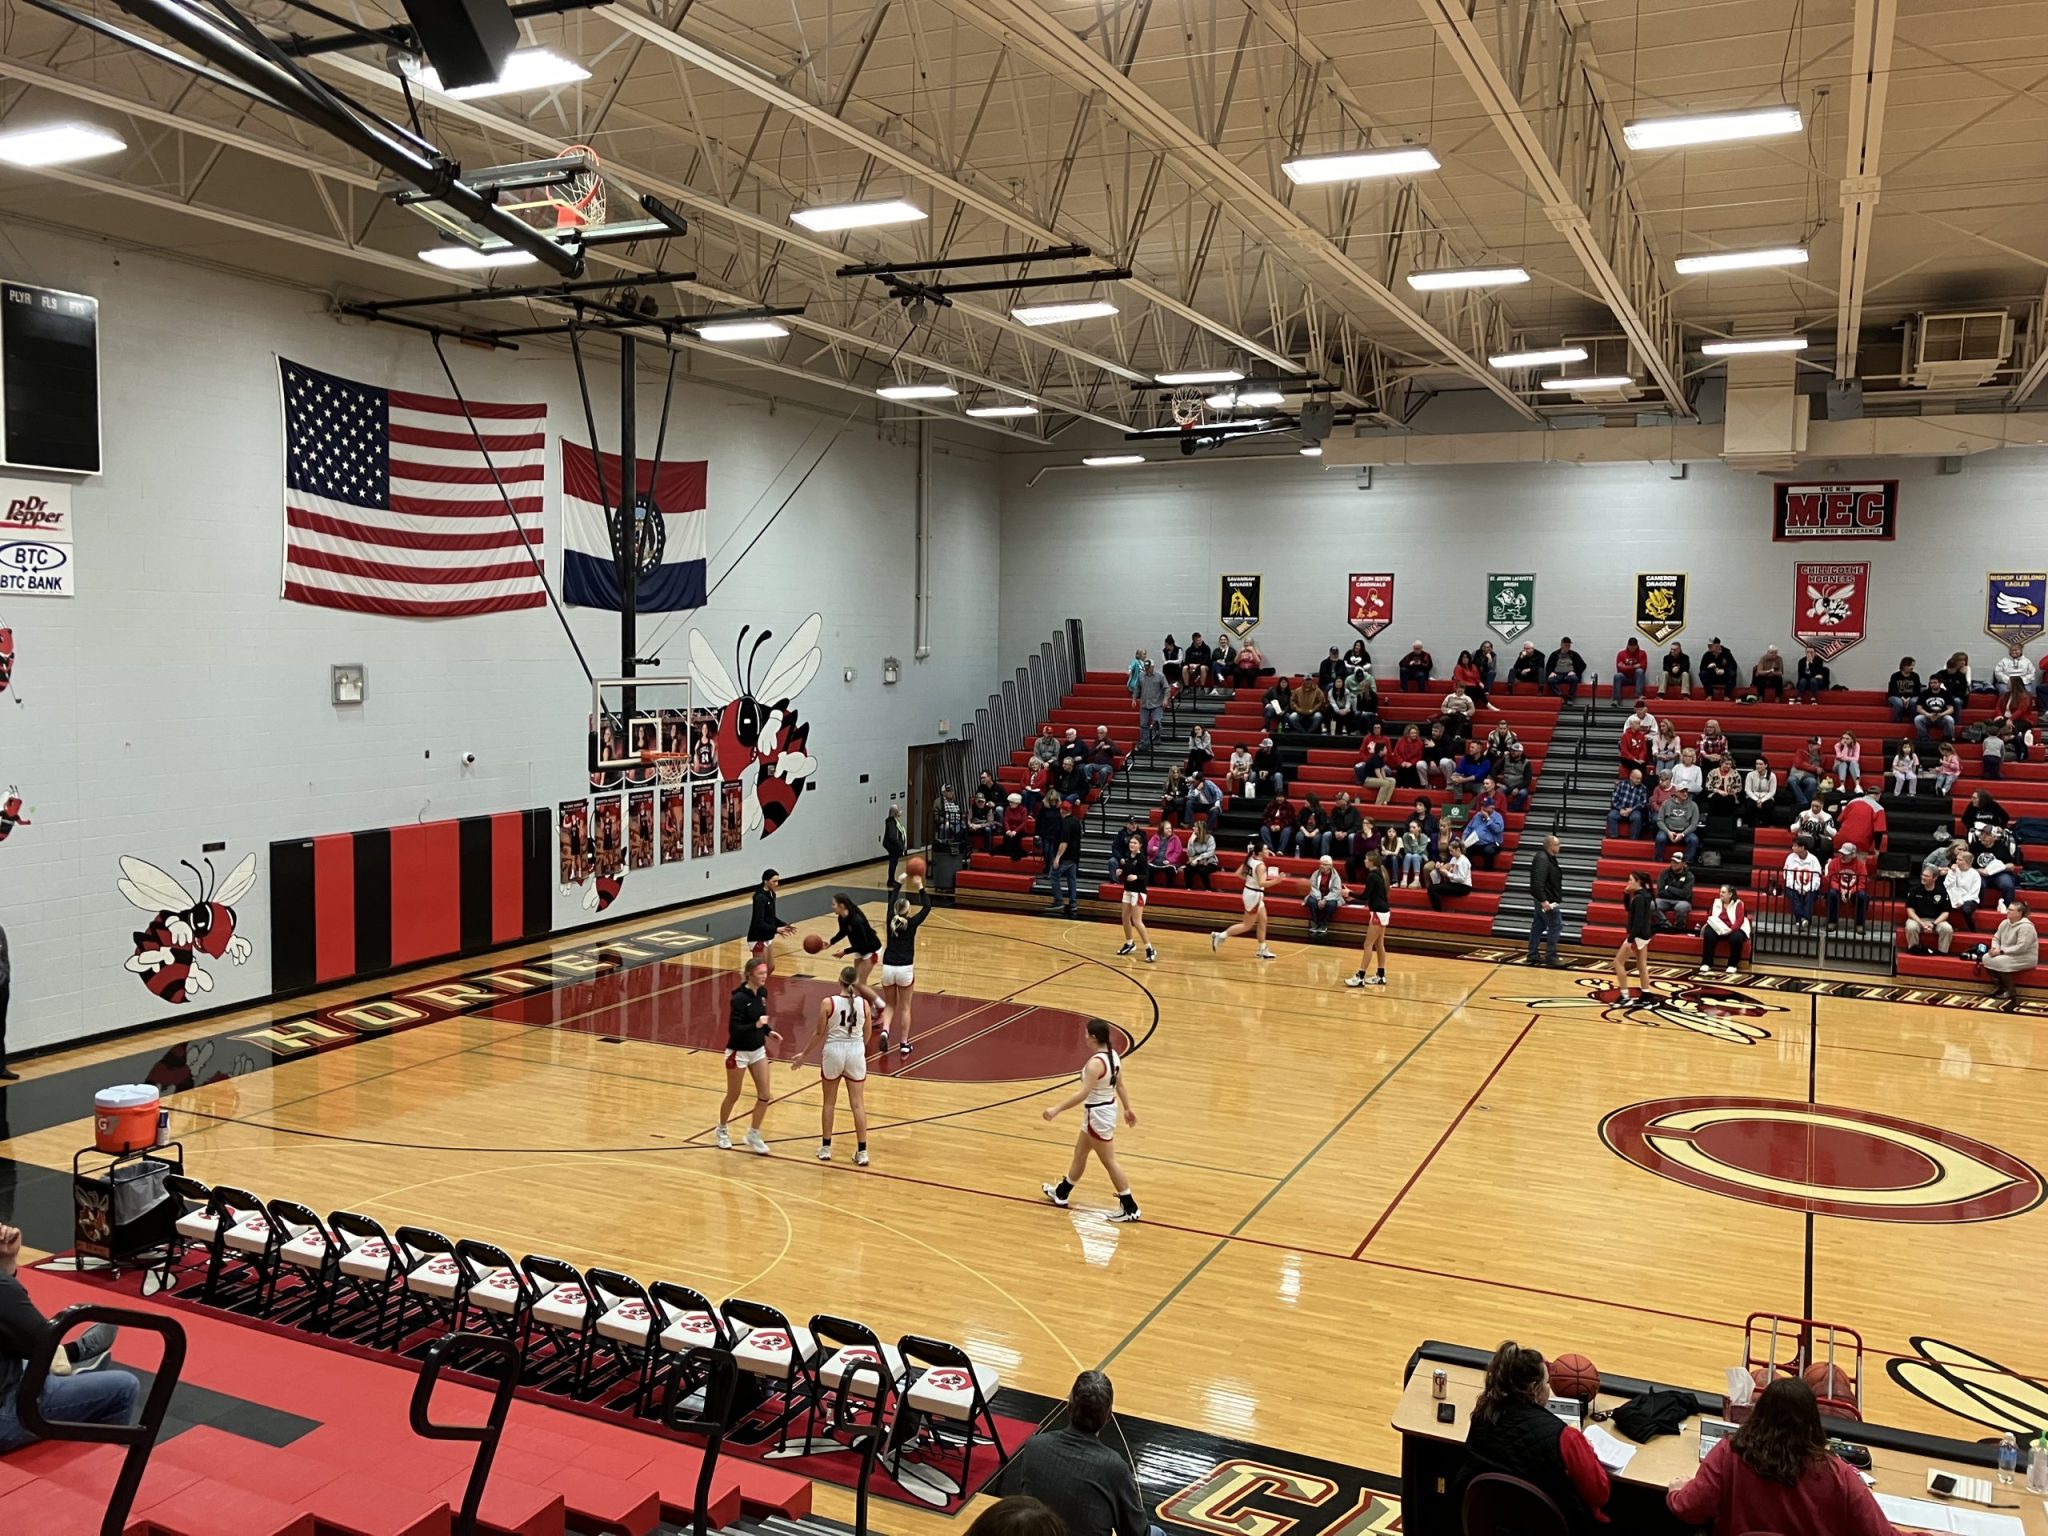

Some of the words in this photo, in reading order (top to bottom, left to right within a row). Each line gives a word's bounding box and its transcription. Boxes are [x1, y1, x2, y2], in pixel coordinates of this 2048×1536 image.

[9, 289, 32, 305] PLYR
[41, 296, 57, 310] FLS
[68, 301, 84, 315] PTS
[25, 496, 48, 511] Dr
[1785, 492, 1885, 528] MEC
[5, 499, 64, 526] Pepper
[15, 548, 48, 565] BTC
[0, 575, 25, 588] BTC
[28, 576, 62, 590] BANK
[1808, 575, 1855, 583] HORNETS
[226, 930, 716, 1055] HORNETS
[840, 1010, 857, 1026] 14
